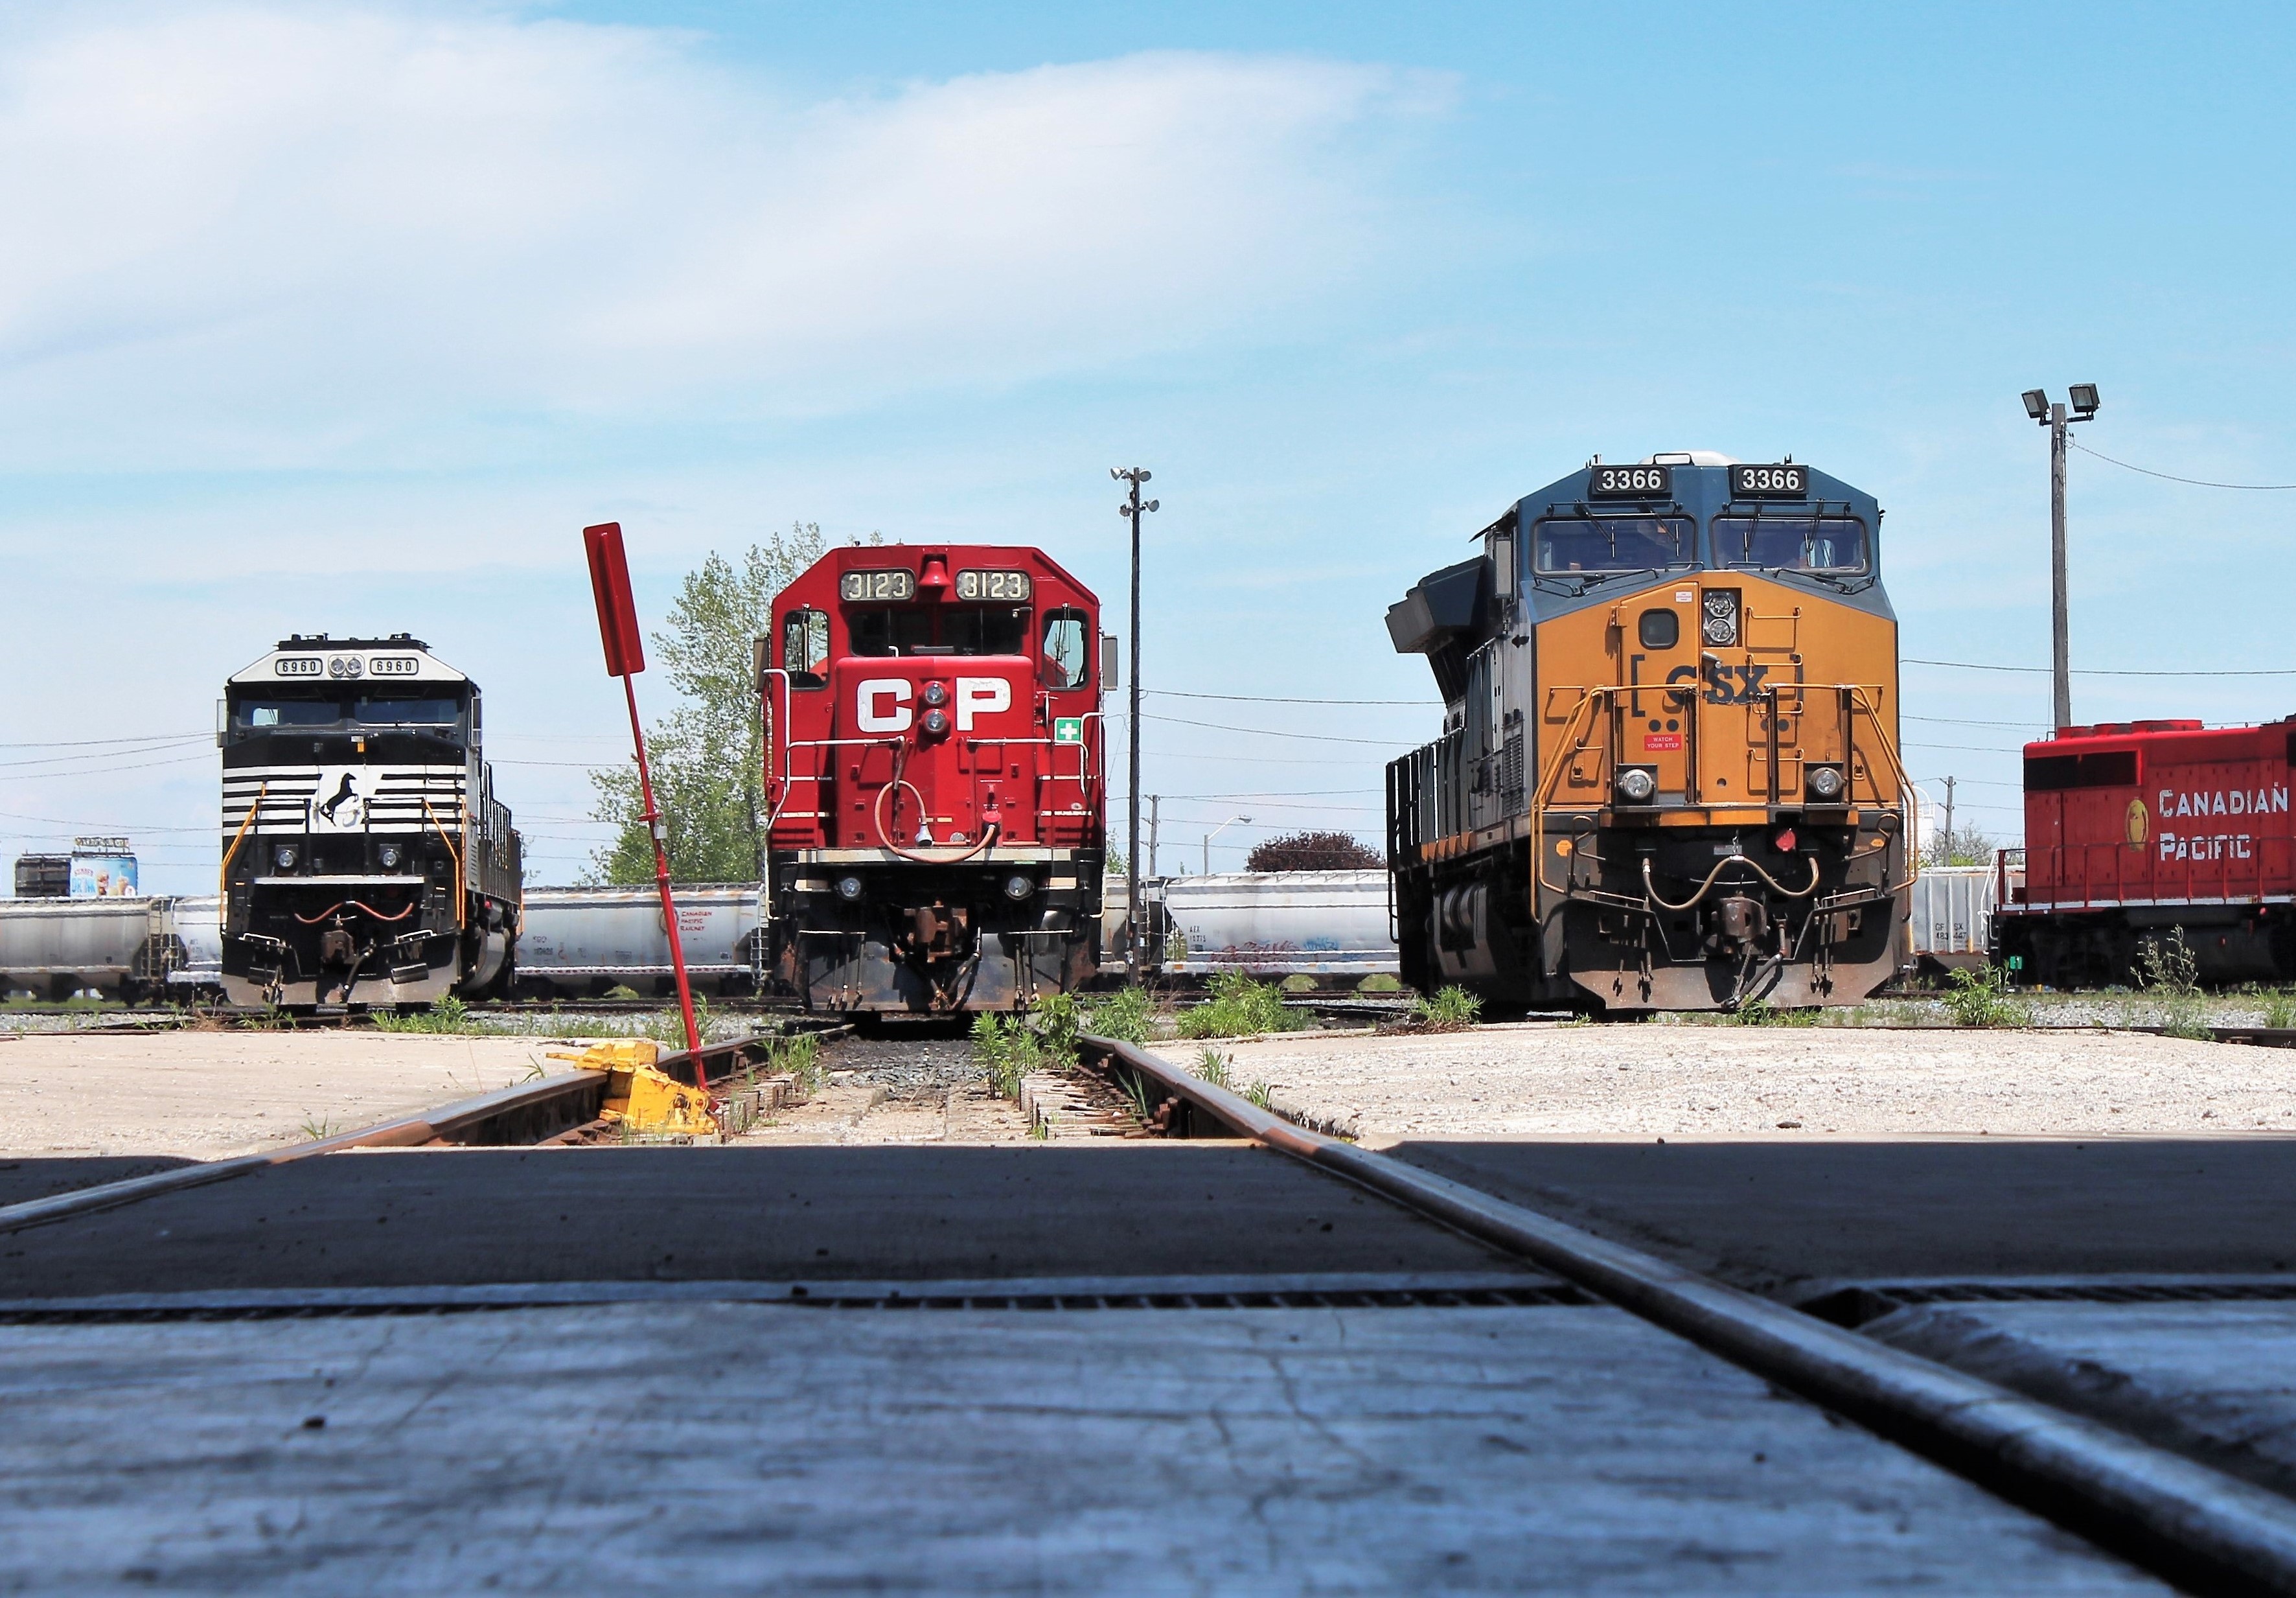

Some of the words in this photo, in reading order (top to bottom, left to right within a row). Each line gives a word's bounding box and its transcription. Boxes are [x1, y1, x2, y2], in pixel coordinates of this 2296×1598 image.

[1602, 470, 1661, 489] 3366
[1742, 469, 1799, 489] 3366
[849, 573, 906, 598] 3123
[965, 572, 1022, 597] 3123
[282, 661, 316, 672] 6960
[377, 661, 411, 671] 6960
[1666, 665, 1768, 704] CSX
[2159, 787, 2288, 817] CANADIAN
[2159, 833, 2251, 861] PACIFIC
